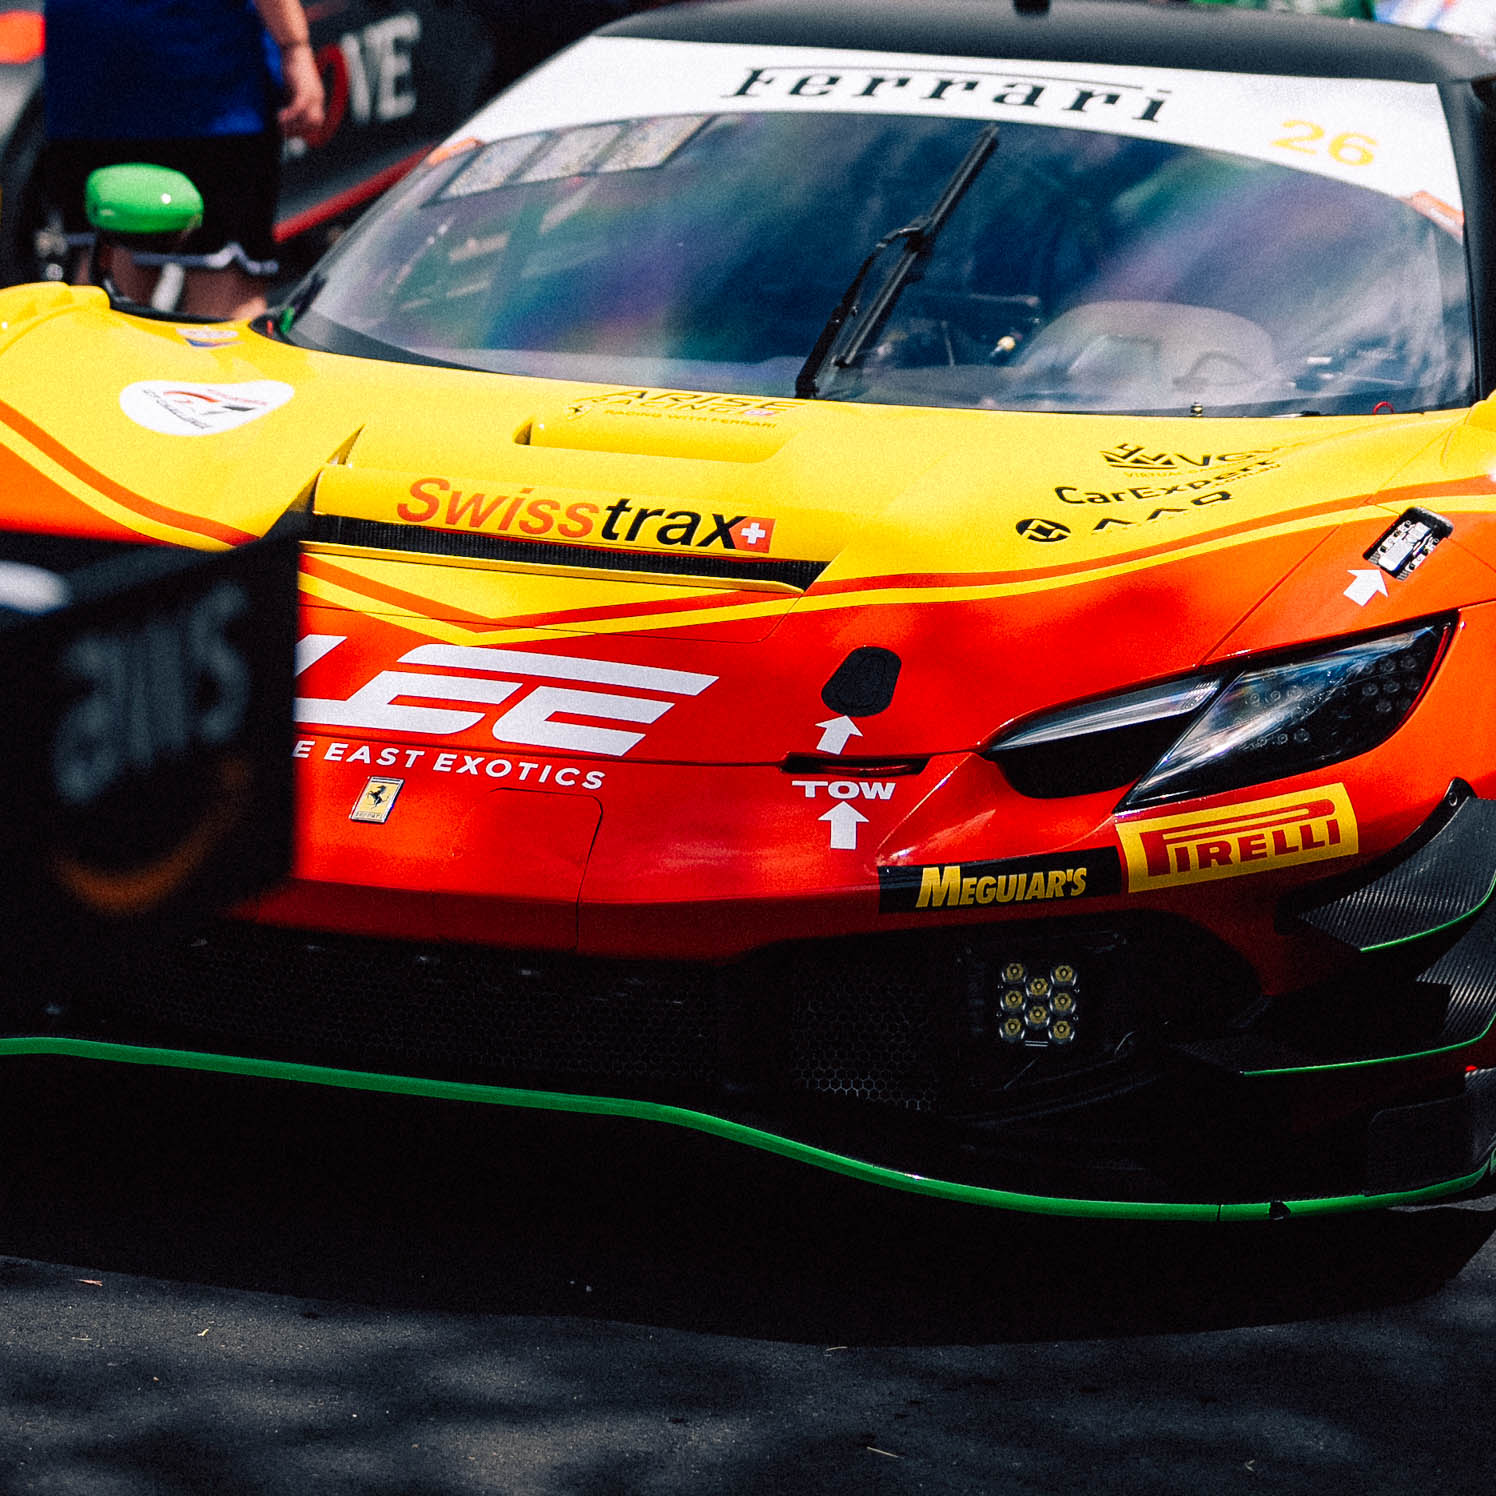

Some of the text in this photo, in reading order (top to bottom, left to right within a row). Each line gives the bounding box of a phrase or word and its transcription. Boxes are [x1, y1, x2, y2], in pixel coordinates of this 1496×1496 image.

[720, 66, 1173, 123] Ferrari
[1271, 119, 1379, 167] 26
[573, 390, 806, 412] ARISE
[1054, 460, 1276, 505] CarExpert
[397, 476, 748, 551] Swisstrax
[323, 741, 426, 768] EAST
[432, 752, 607, 790] EXOTICS
[791, 780, 897, 800] TOW
[1139, 797, 1342, 878] PIRELLI
[915, 865, 1088, 908] MEGUIAR'S
